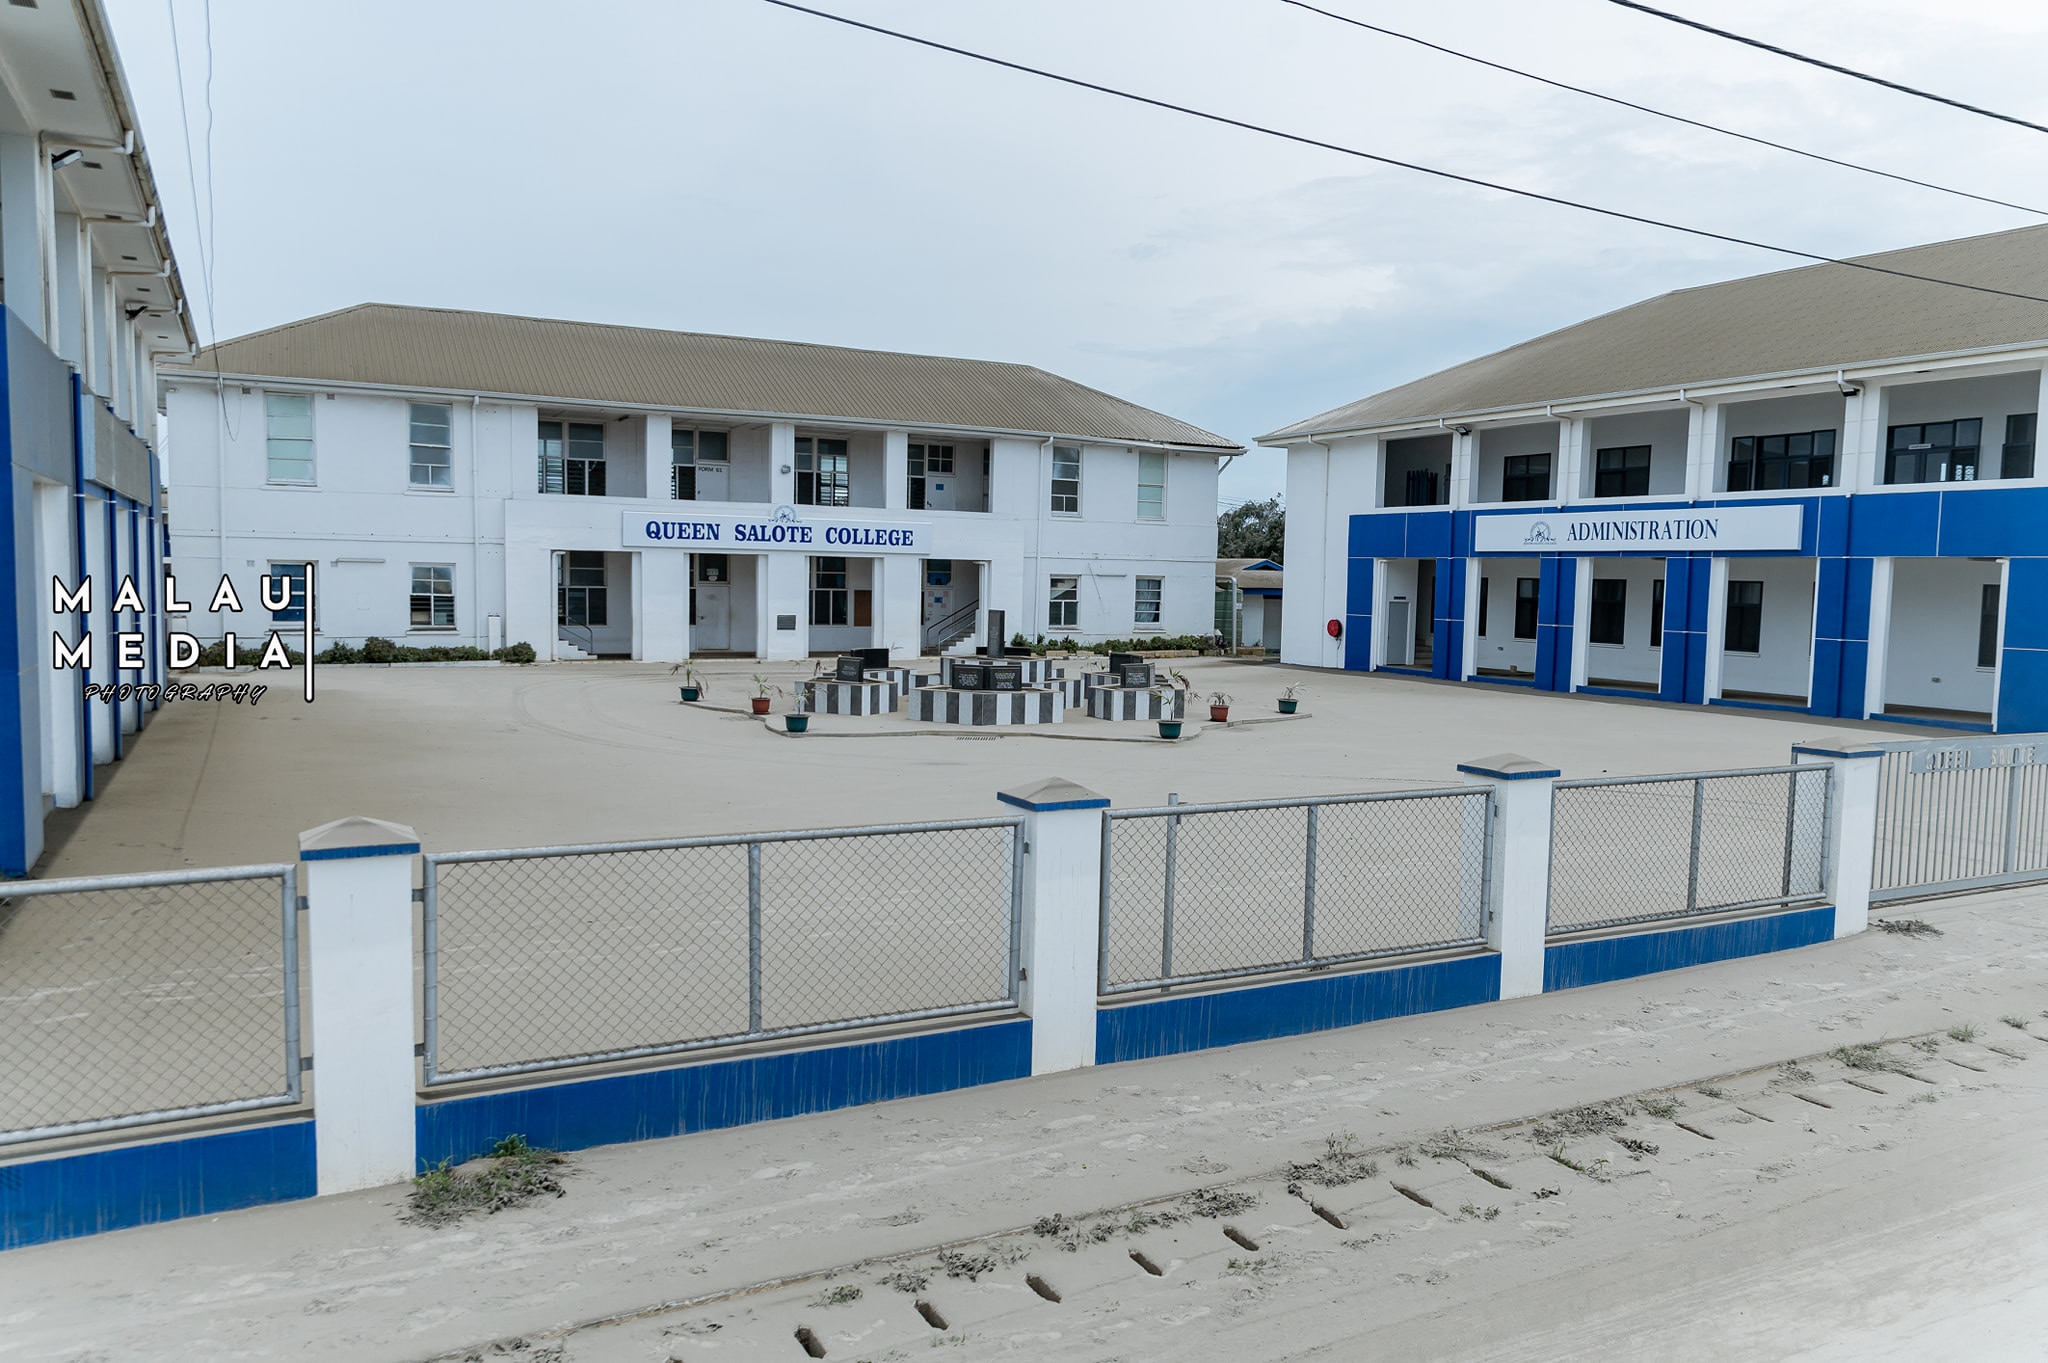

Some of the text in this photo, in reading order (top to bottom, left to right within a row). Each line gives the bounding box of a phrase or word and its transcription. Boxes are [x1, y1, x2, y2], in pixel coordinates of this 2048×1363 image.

[645, 520, 914, 547] QUEEN SALOTE COLLEGE
[1566, 518, 1719, 542] ADMINISTRATION
[1926, 750, 1971, 770] QUEEN
